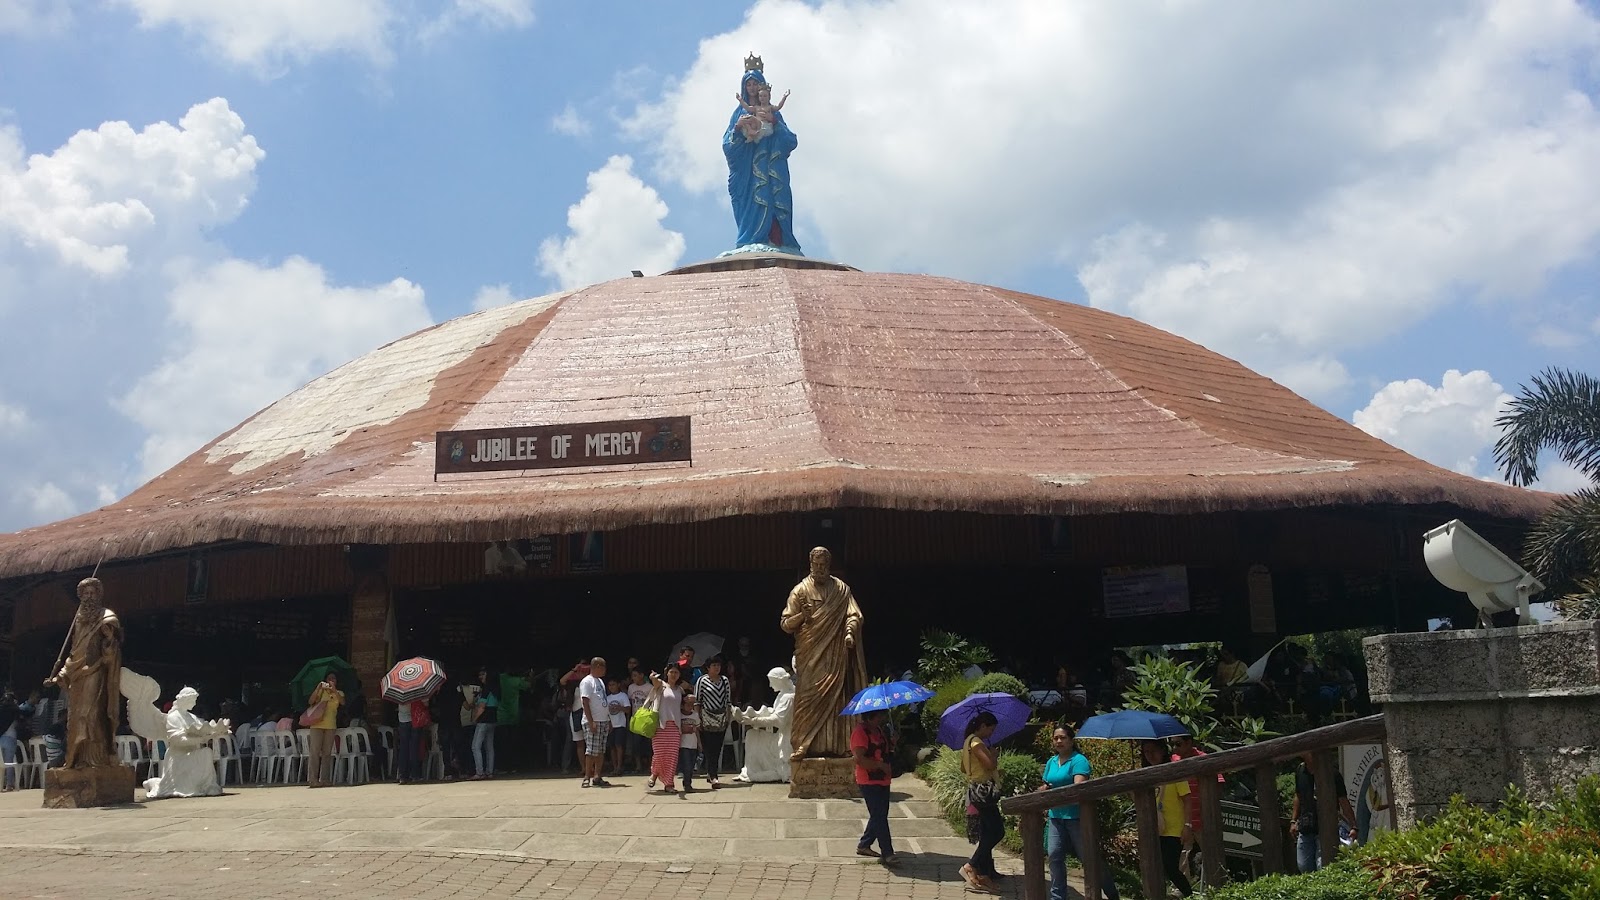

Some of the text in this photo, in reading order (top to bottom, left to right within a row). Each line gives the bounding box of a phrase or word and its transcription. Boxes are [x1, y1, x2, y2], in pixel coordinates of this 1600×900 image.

[470, 431, 642, 463] JUBILEE OF MERCY
[533, 552, 552, 561] destroy
[799, 775, 850, 785] SAN PEDRO
[1349, 745, 1380, 809] HE FATHER
[1229, 813, 1248, 821] CANDLES
[1222, 817, 1262, 831] VAILABLE HE
